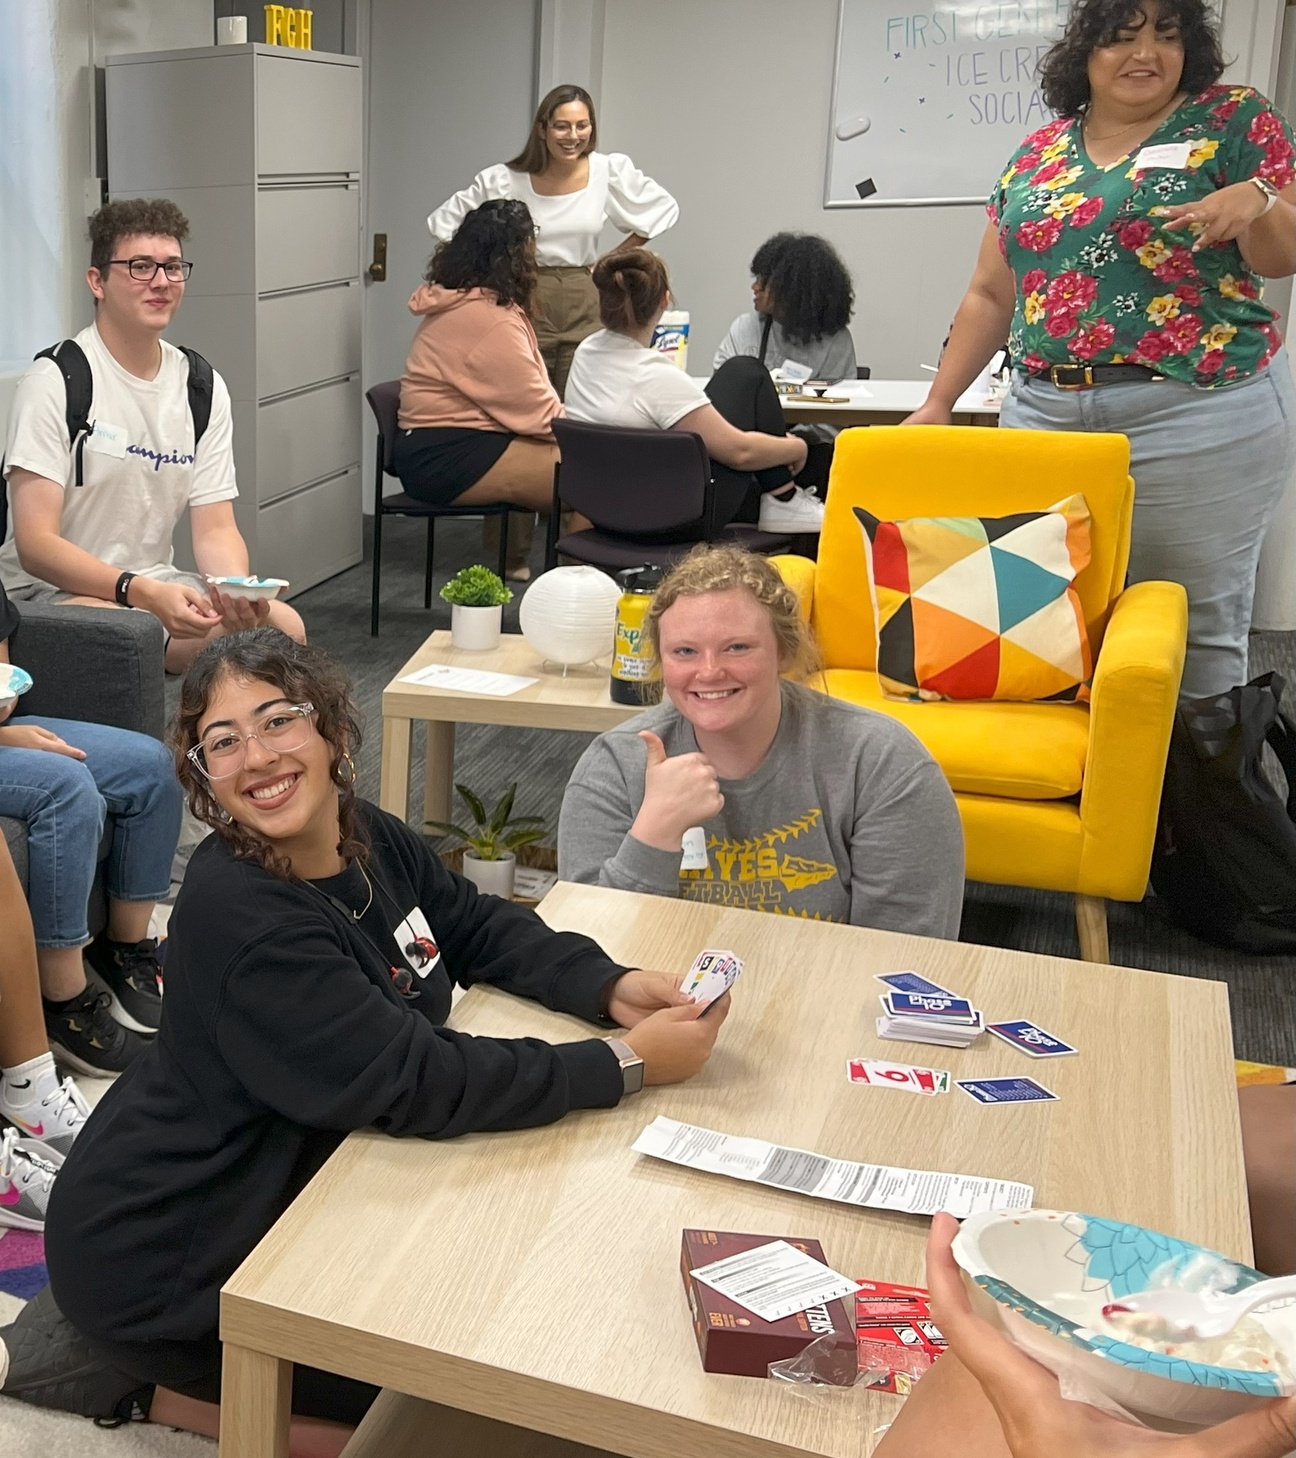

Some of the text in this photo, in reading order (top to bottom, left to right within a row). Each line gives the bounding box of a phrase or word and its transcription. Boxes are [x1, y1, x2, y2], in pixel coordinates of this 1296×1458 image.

[264, 4, 313, 50] FGH
[946, 52, 988, 86] ICE
[969, 88, 1046, 126] SOCIA
[126, 444, 194, 471] ampion
[679, 848, 778, 881] YES
